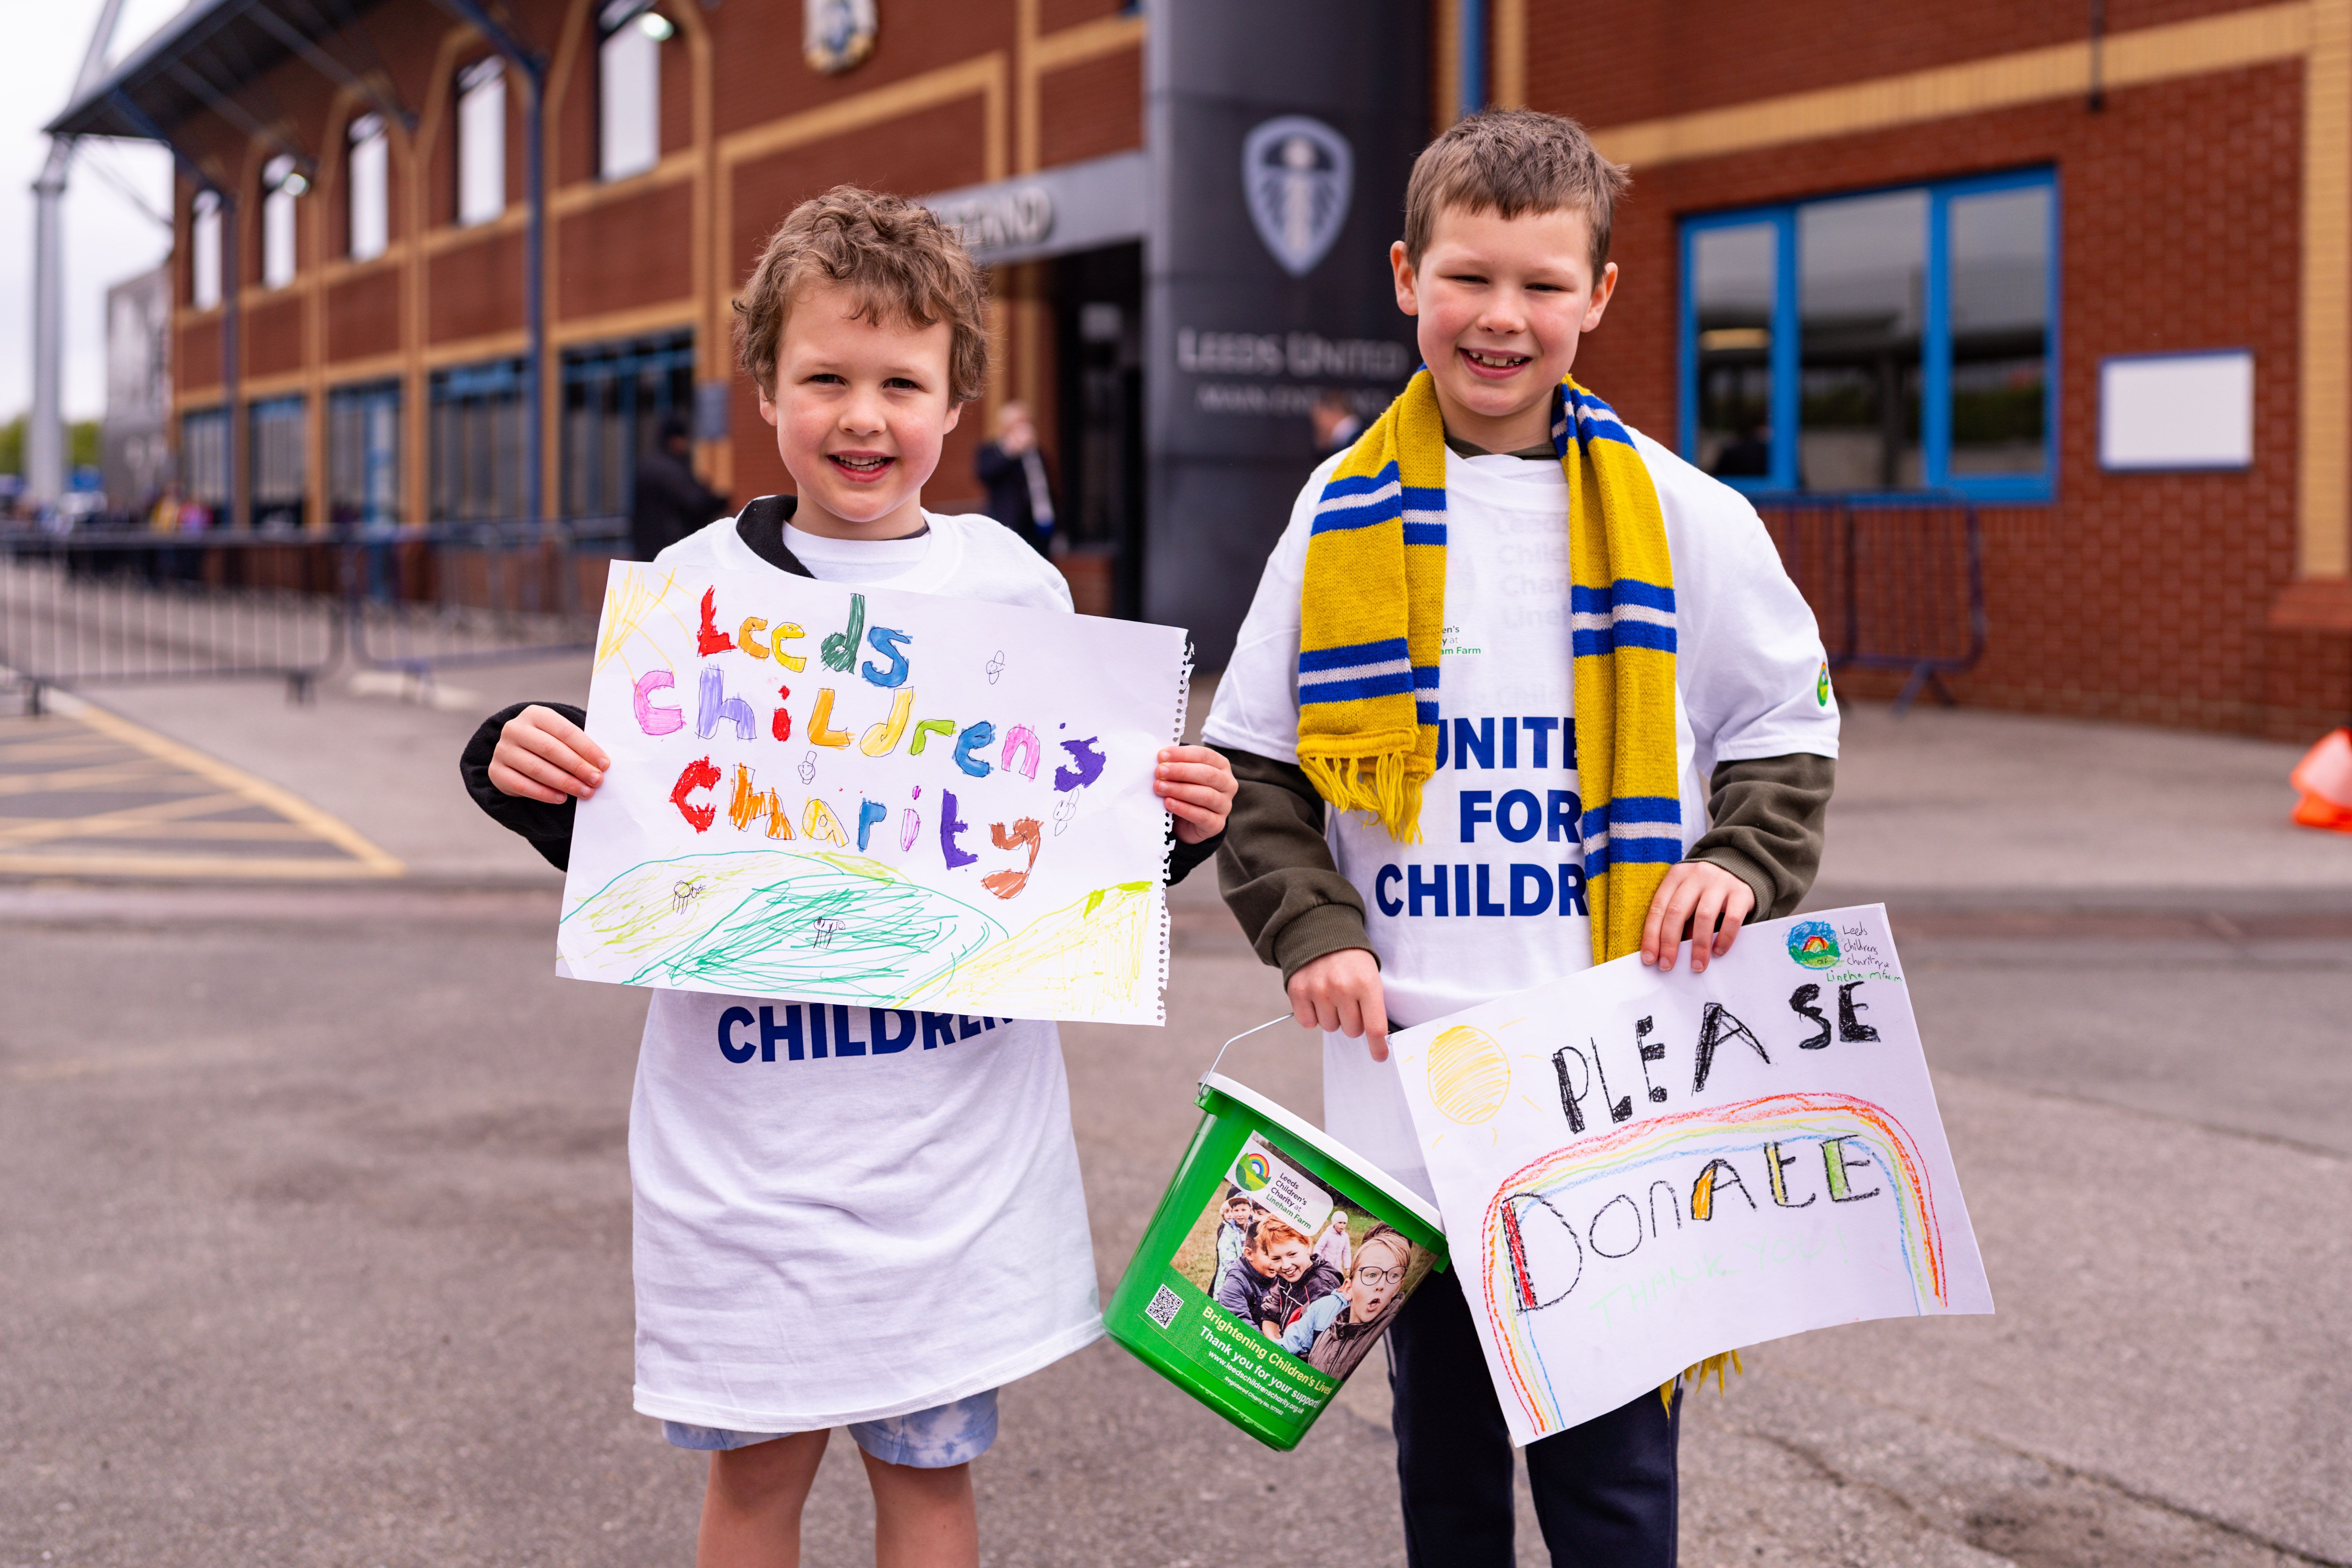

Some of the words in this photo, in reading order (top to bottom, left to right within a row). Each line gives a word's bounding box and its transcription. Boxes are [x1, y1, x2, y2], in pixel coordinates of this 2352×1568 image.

[696, 584, 913, 688] Leeds
[1460, 789, 1581, 843] FOR
[1843, 921, 1867, 936] Leeds
[1271, 1187, 1295, 1207] Charity
[1276, 1180, 1307, 1205] Children's
[1280, 1172, 1299, 1189] Leeds
[1266, 1194, 1293, 1217] Lineham
[1294, 1214, 1311, 1229] Farm
[1200, 1325, 1233, 1356] Thank
[1230, 1352, 1254, 1370] you
[1254, 1365, 1270, 1380] for
[1268, 1377, 1292, 1394] your
[1291, 1390, 1321, 1408] support!
[1202, 1306, 1268, 1359] Brightening
[1269, 1353, 1315, 1387] Children's
[1314, 1380, 1332, 1395] Lives
[1209, 1351, 1304, 1414] www.leedschildrenscharity.org.uk
[1224, 1376, 1249, 1395] Registered
[1248, 1392, 1264, 1405] Charity
